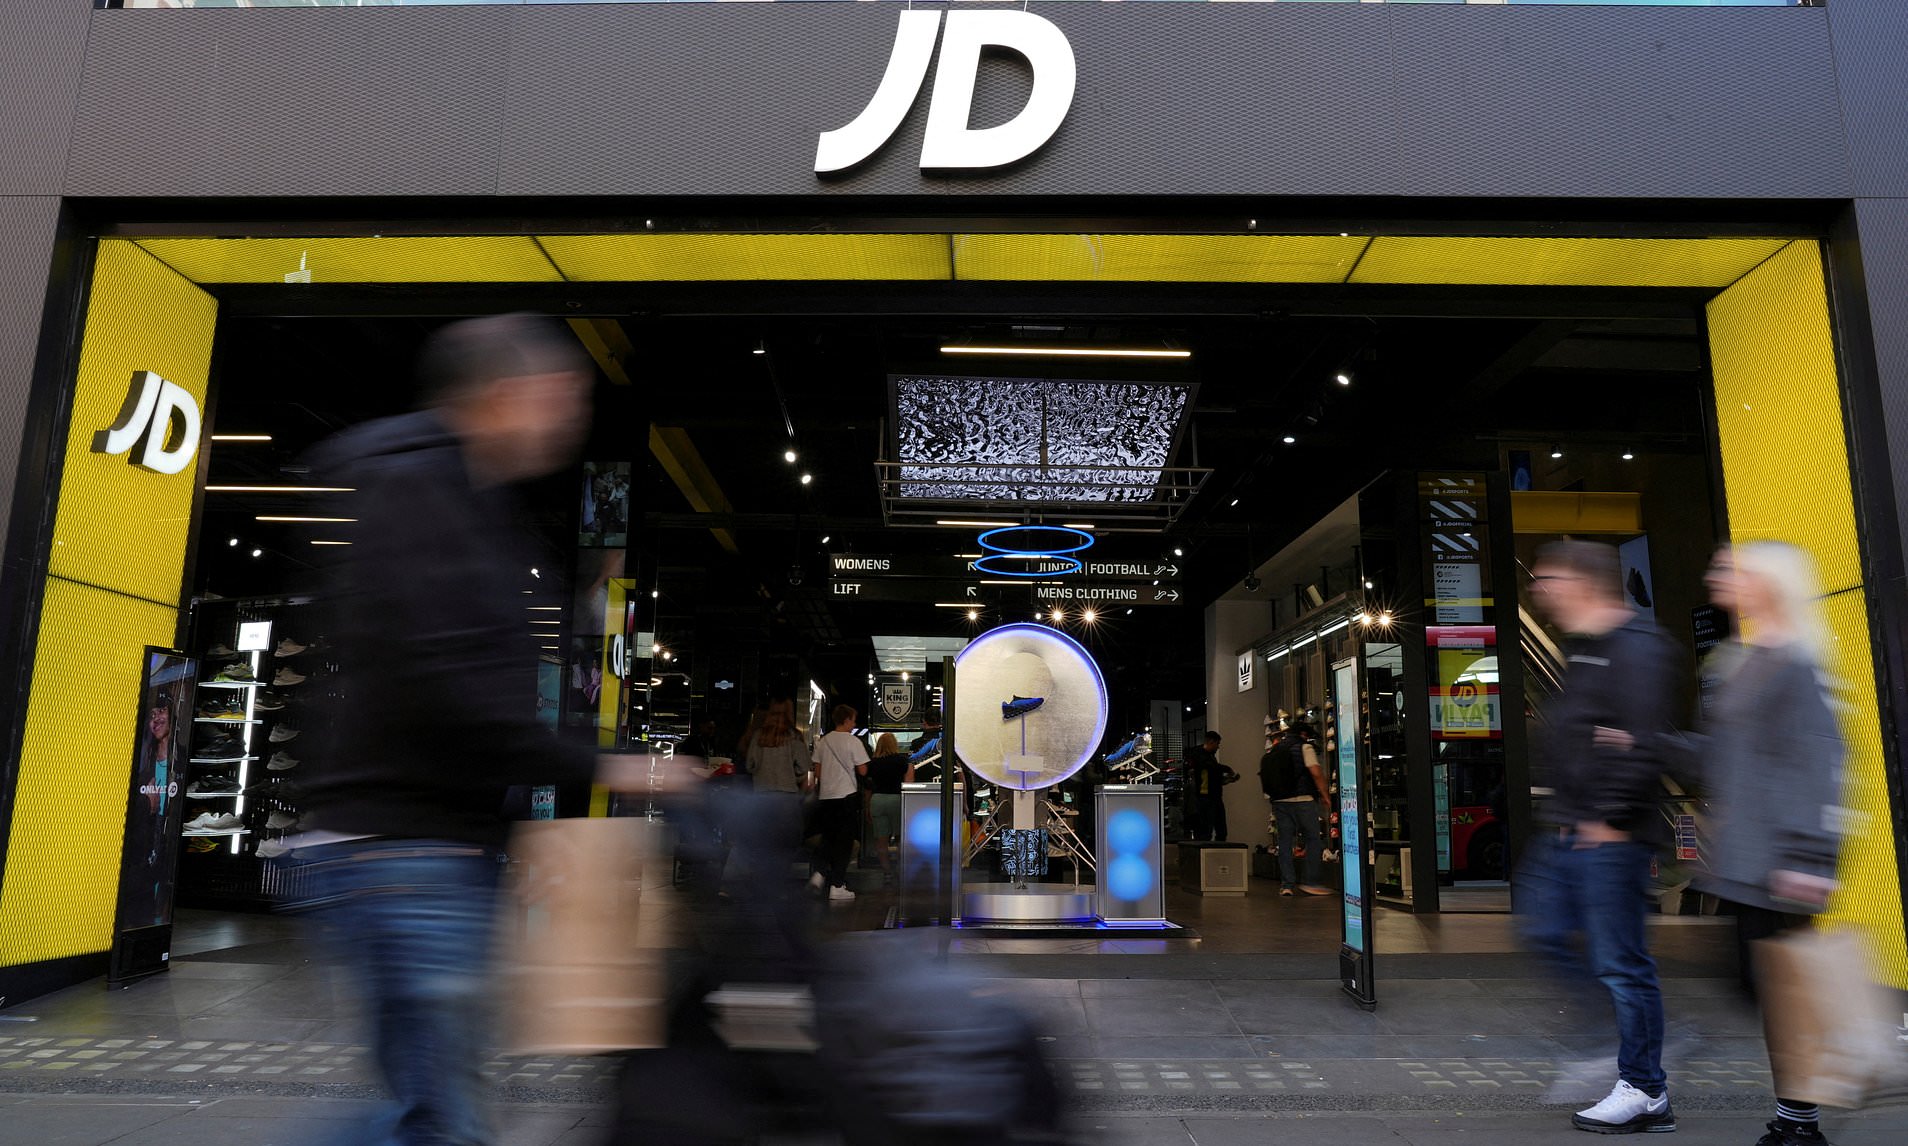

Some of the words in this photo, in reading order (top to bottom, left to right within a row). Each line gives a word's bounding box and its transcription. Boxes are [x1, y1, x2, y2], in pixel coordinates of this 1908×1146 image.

[814, 9, 1077, 175] JD
[95, 370, 201, 475] JD
[834, 558, 890, 570] WOMENS
[1090, 563, 1150, 576] FOOTBALL
[834, 583, 861, 595] LIFT
[1037, 587, 1073, 599] MENS
[1076, 588, 1137, 600] CLOTHING
[886, 694, 909, 702] KING
